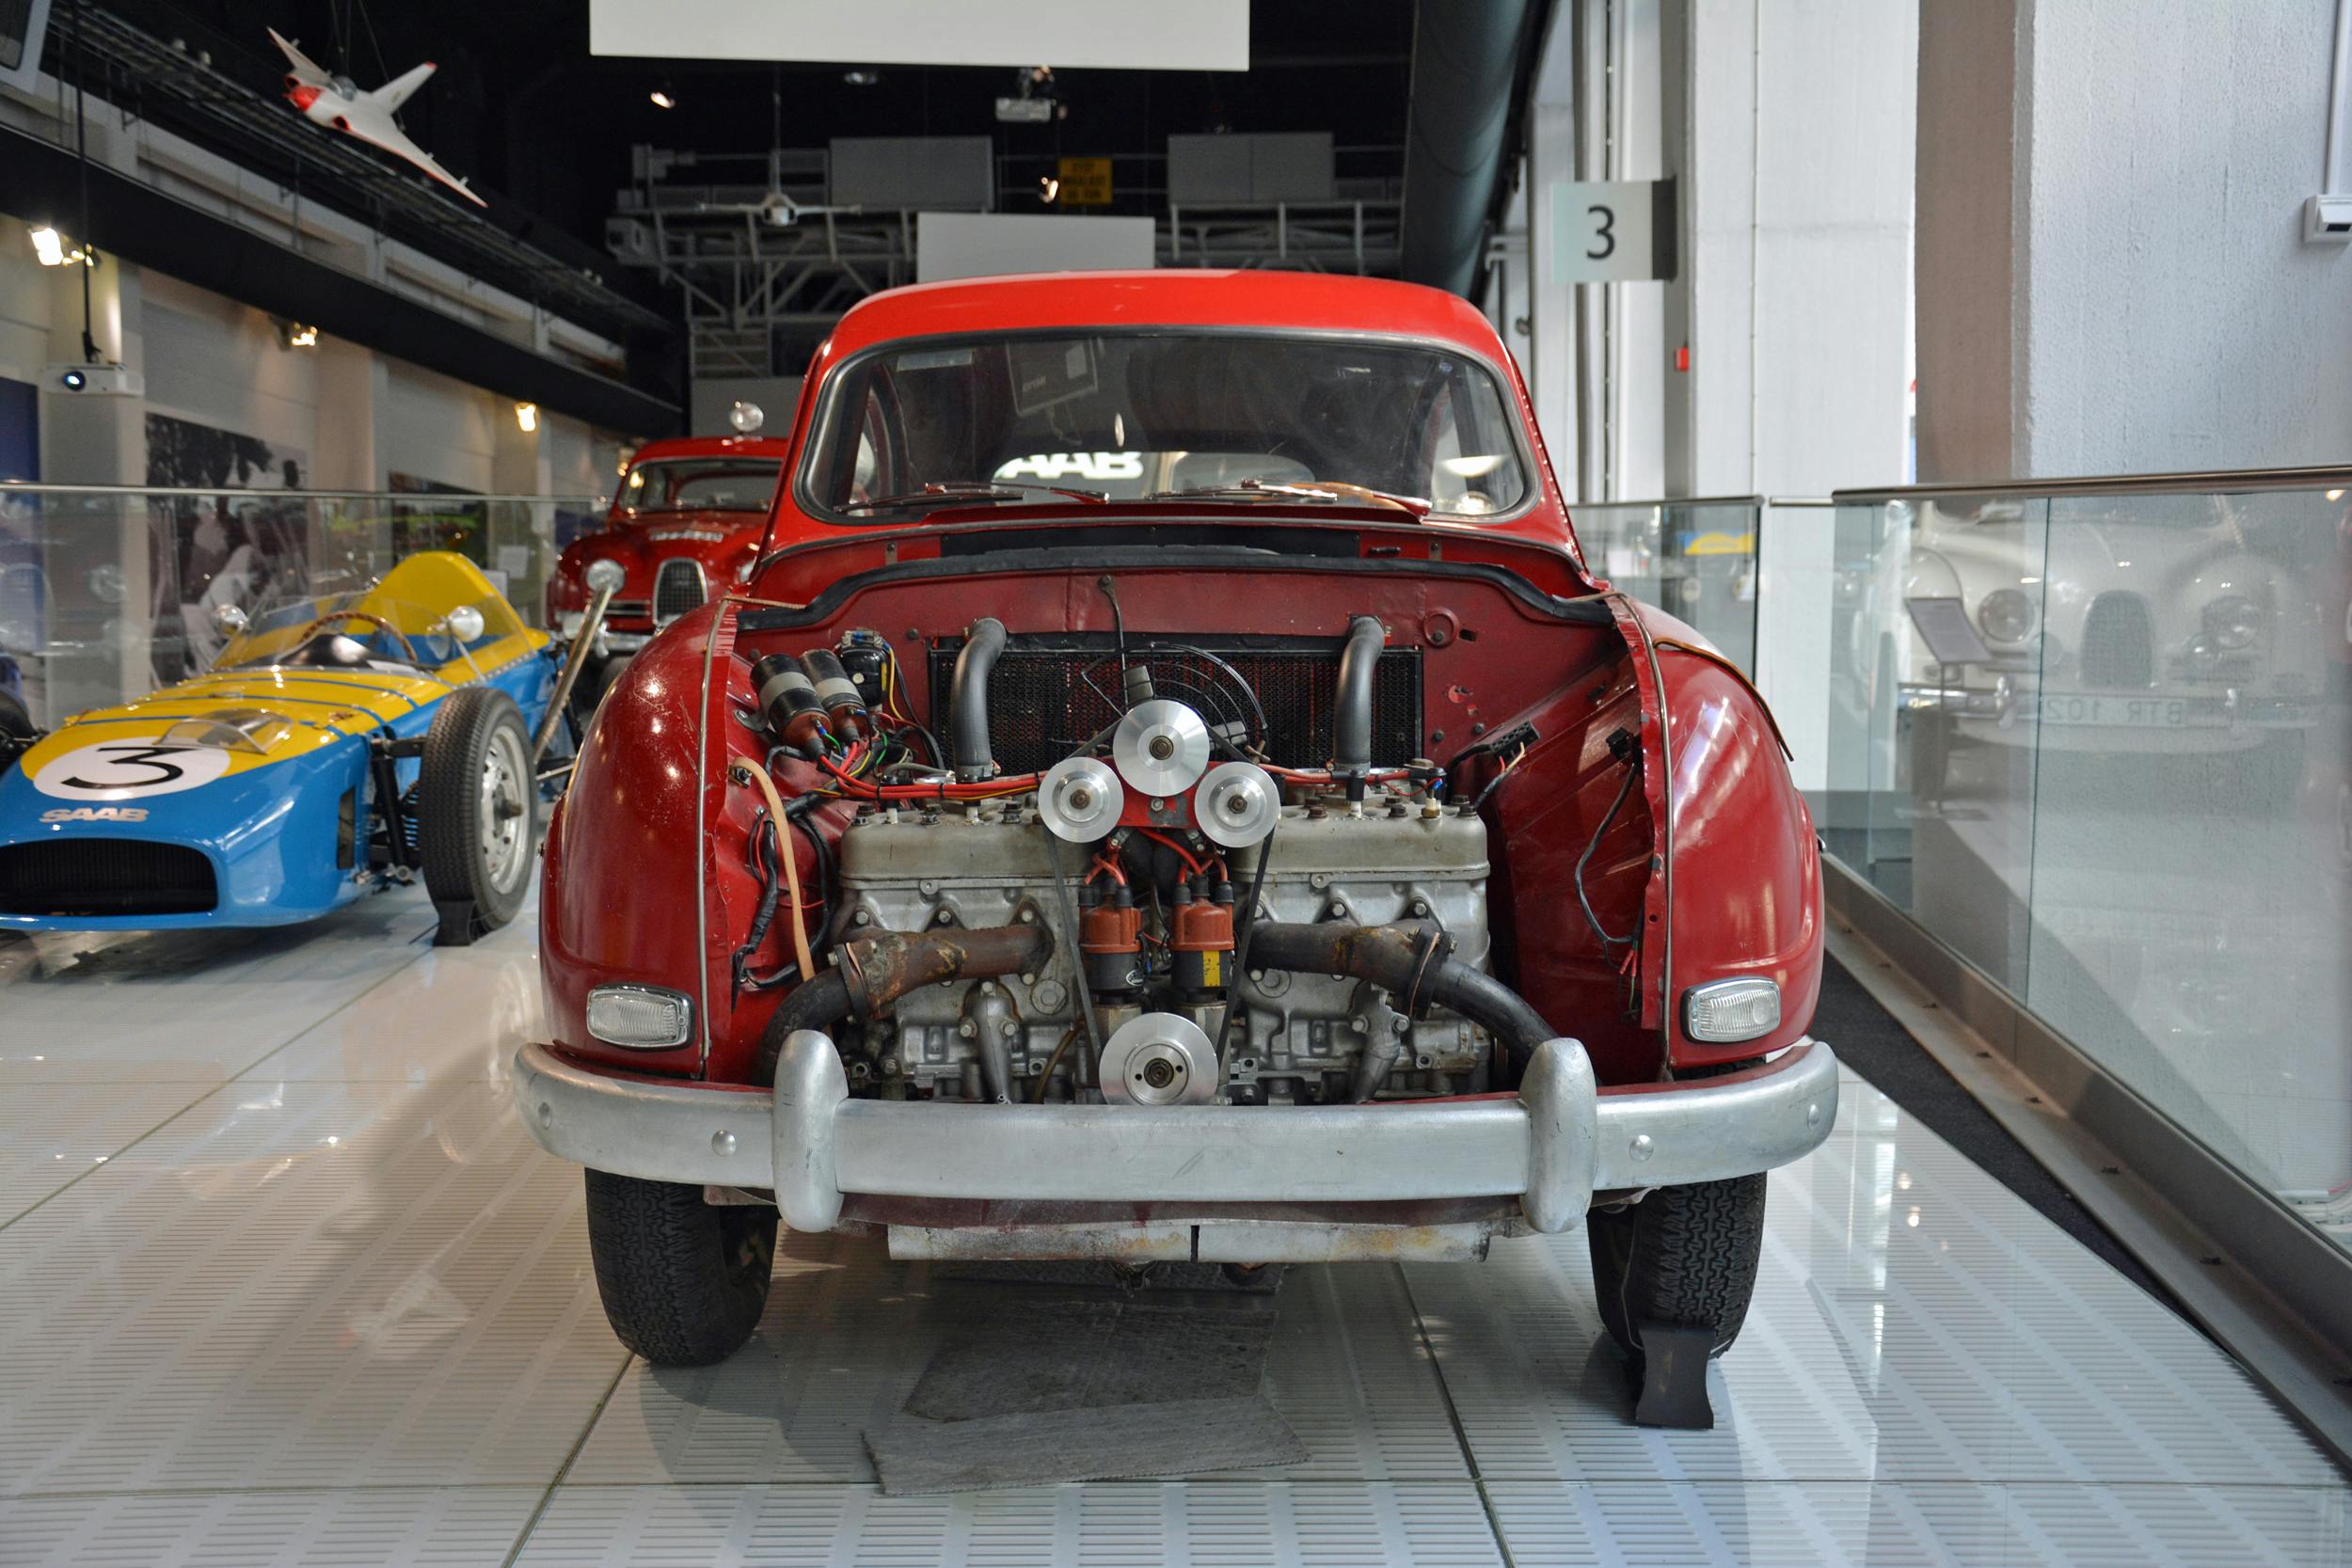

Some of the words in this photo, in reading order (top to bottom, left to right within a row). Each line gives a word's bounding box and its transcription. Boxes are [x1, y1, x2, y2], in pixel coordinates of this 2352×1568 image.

[1586, 205, 1615, 261] 3
[993, 451, 1144, 479] AAB
[60, 747, 199, 789] 3
[40, 807, 150, 823] SAAB
